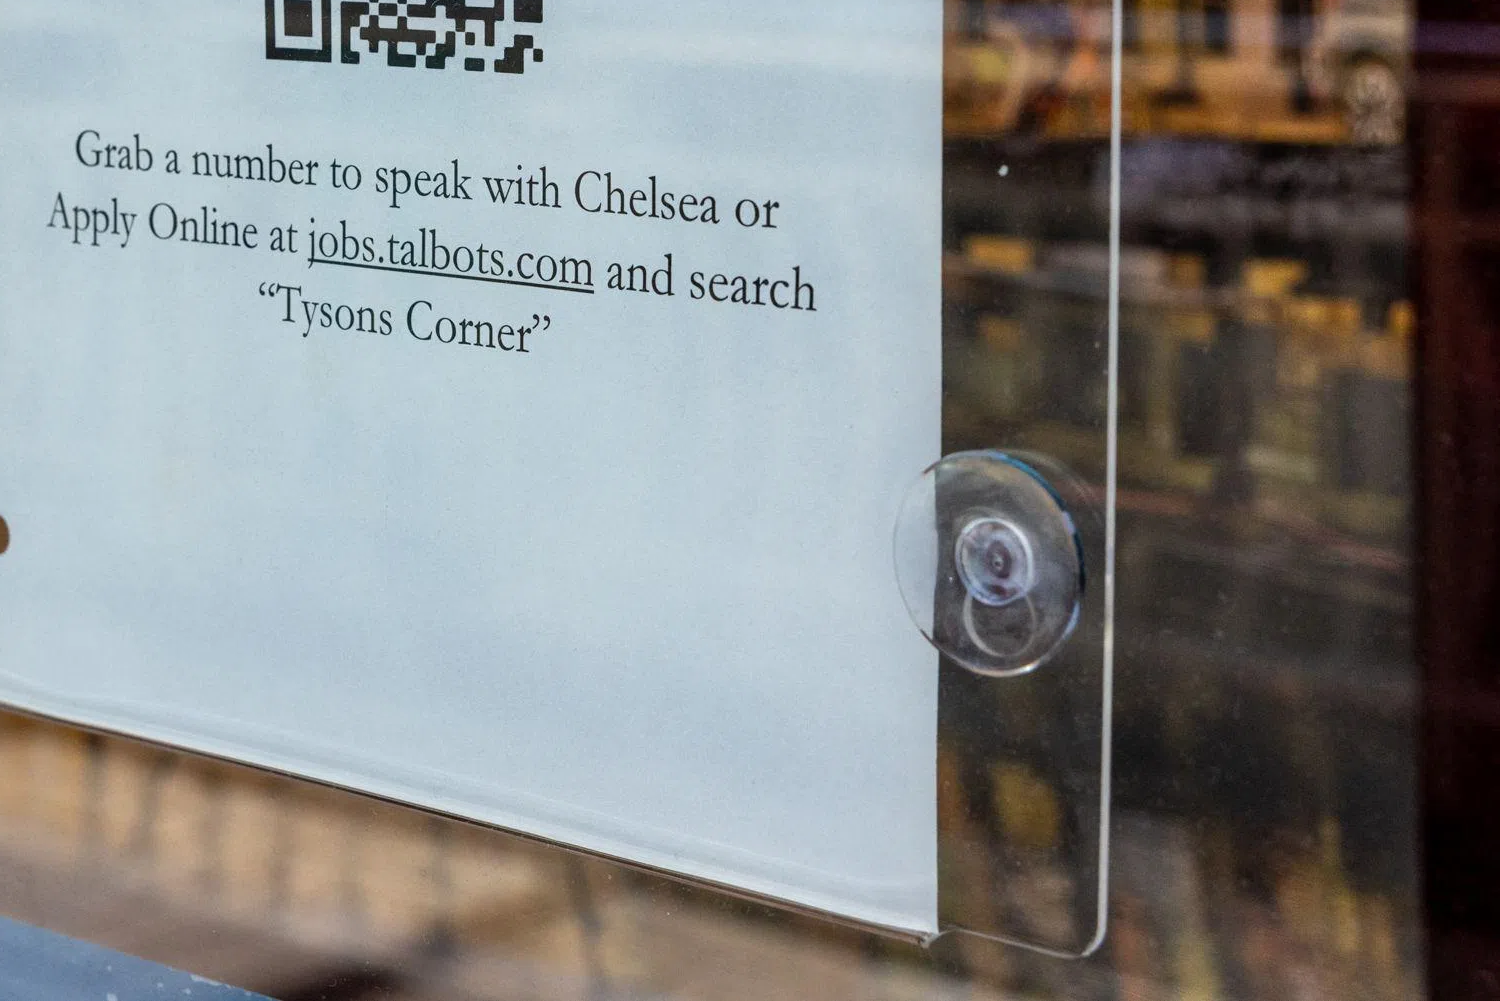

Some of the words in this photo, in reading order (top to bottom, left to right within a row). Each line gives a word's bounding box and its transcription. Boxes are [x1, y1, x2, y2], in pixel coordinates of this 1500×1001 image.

[75, 129, 154, 172] Grab
[164, 149, 181, 175] a
[191, 143, 320, 186] number
[329, 158, 362, 191] to
[374, 158, 474, 209] speak
[481, 165, 562, 209] with
[574, 170, 721, 225] Chelsea
[734, 198, 780, 229] or
[46, 191, 138, 249] Apply
[148, 202, 258, 250] Online
[269, 223, 299, 254] at
[306, 219, 595, 294] jobs.talbots.com
[606, 252, 676, 297] and
[689, 265, 818, 312] search
[258, 281, 393, 338] “Tysons
[406, 300, 552, 354] Corner”
